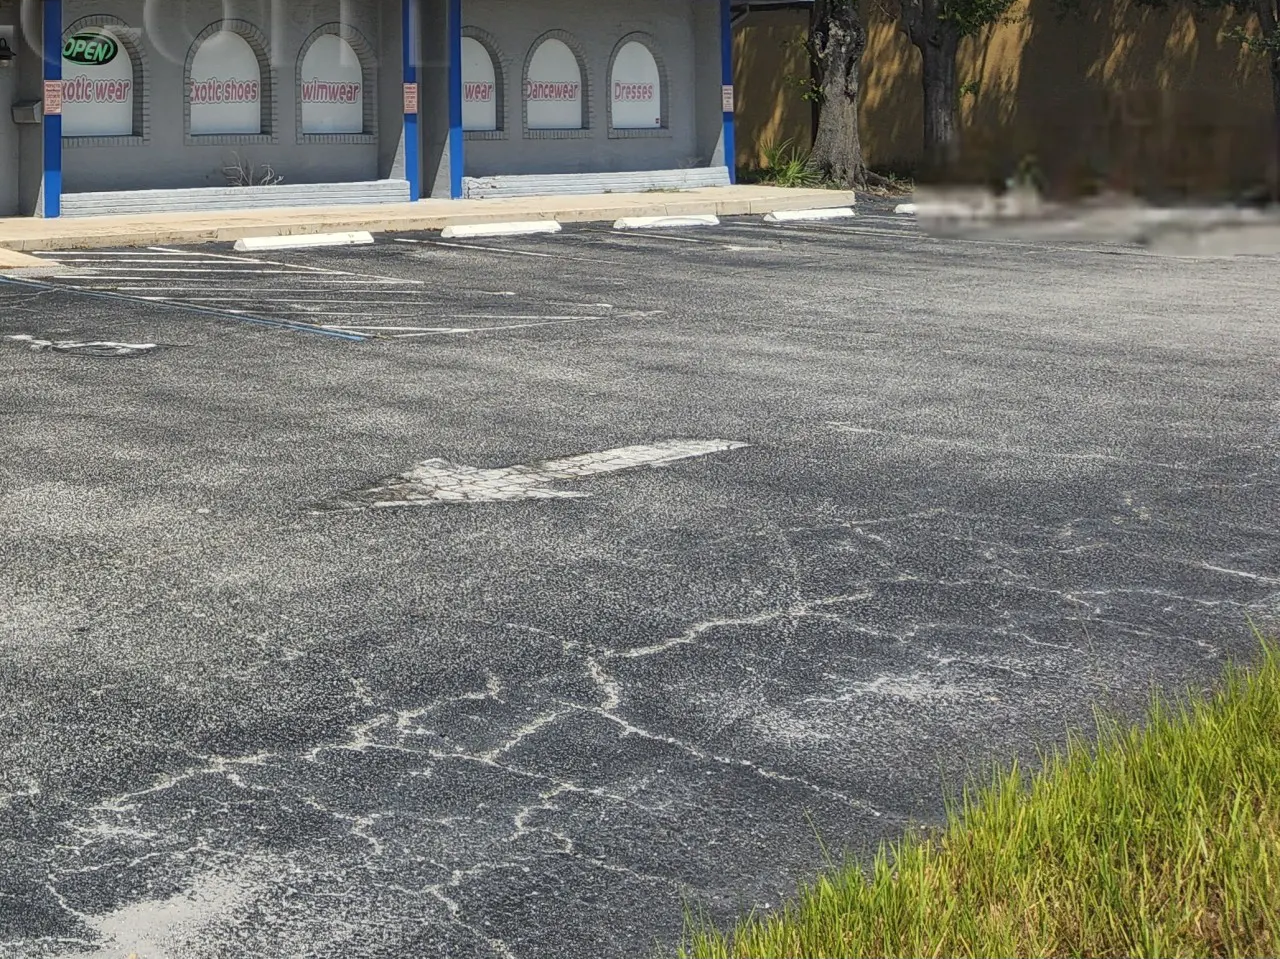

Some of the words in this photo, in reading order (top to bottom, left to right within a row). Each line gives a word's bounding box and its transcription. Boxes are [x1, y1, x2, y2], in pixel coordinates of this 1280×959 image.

[62, 38, 109, 62] OPEN
[62, 77, 92, 101] xotic
[94, 81, 130, 102] wear
[223, 79, 258, 101] shoes
[302, 79, 359, 102] wimwear
[464, 82, 493, 100] wear
[526, 81, 578, 100] Dancewear
[614, 82, 653, 100] Dresses
